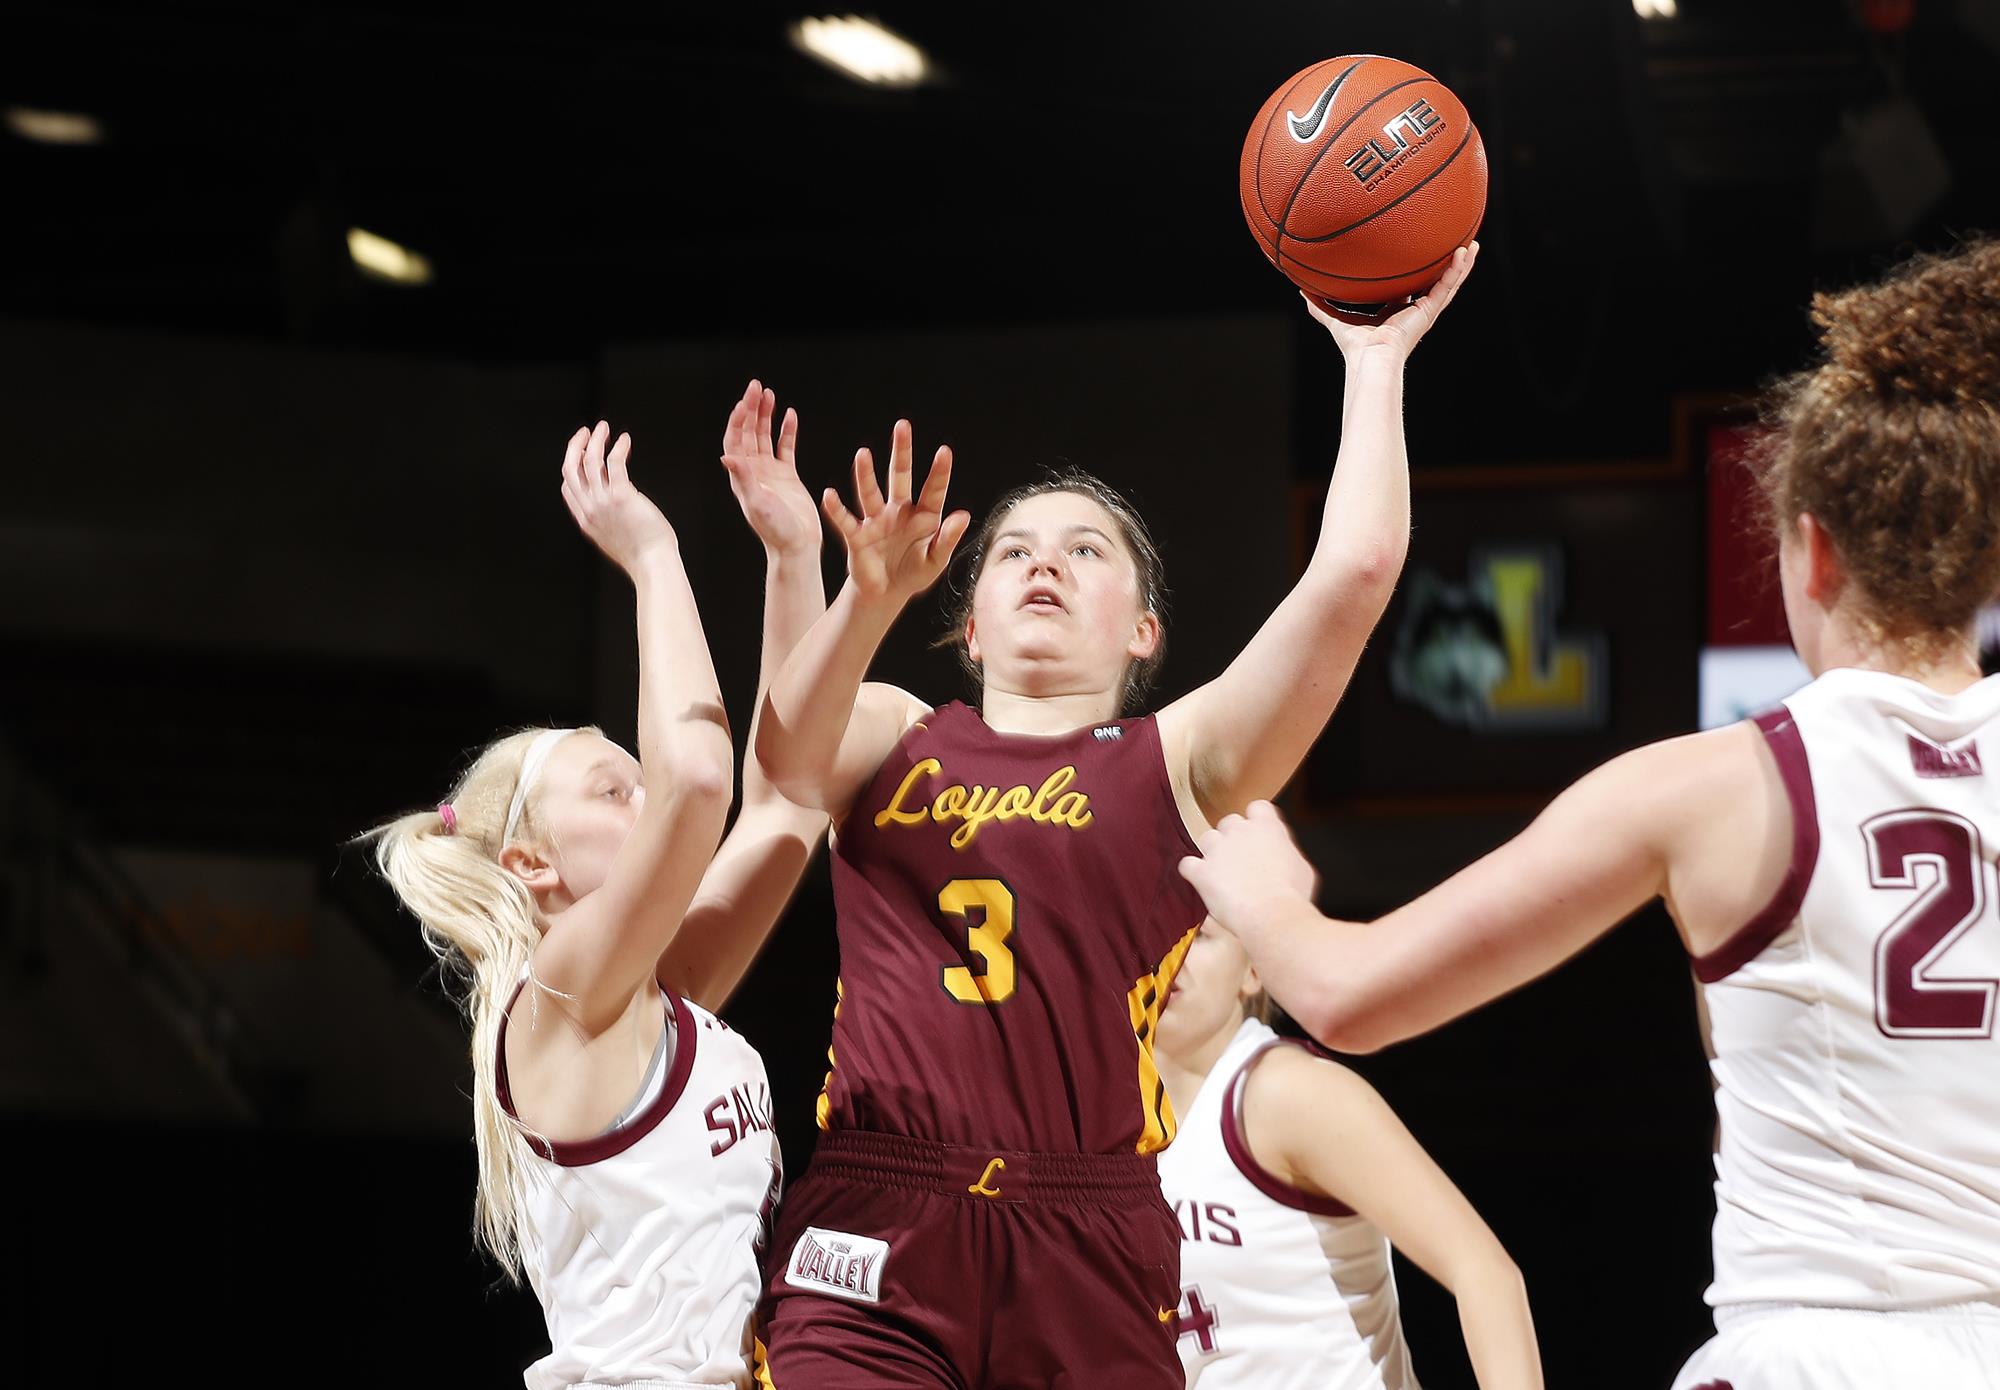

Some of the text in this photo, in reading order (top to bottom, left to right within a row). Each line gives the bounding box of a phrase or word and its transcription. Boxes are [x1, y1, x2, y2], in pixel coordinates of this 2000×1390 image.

[1365, 122, 1447, 193] CHAMPIONSHIP
[1093, 726, 1122, 742] ONE
[874, 757, 1095, 849] Loyola
[936, 877, 1018, 1003] 3
[1859, 807, 2000, 1039] 2
[967, 1157, 1005, 1196] L
[793, 1232, 880, 1296] VALLEY
